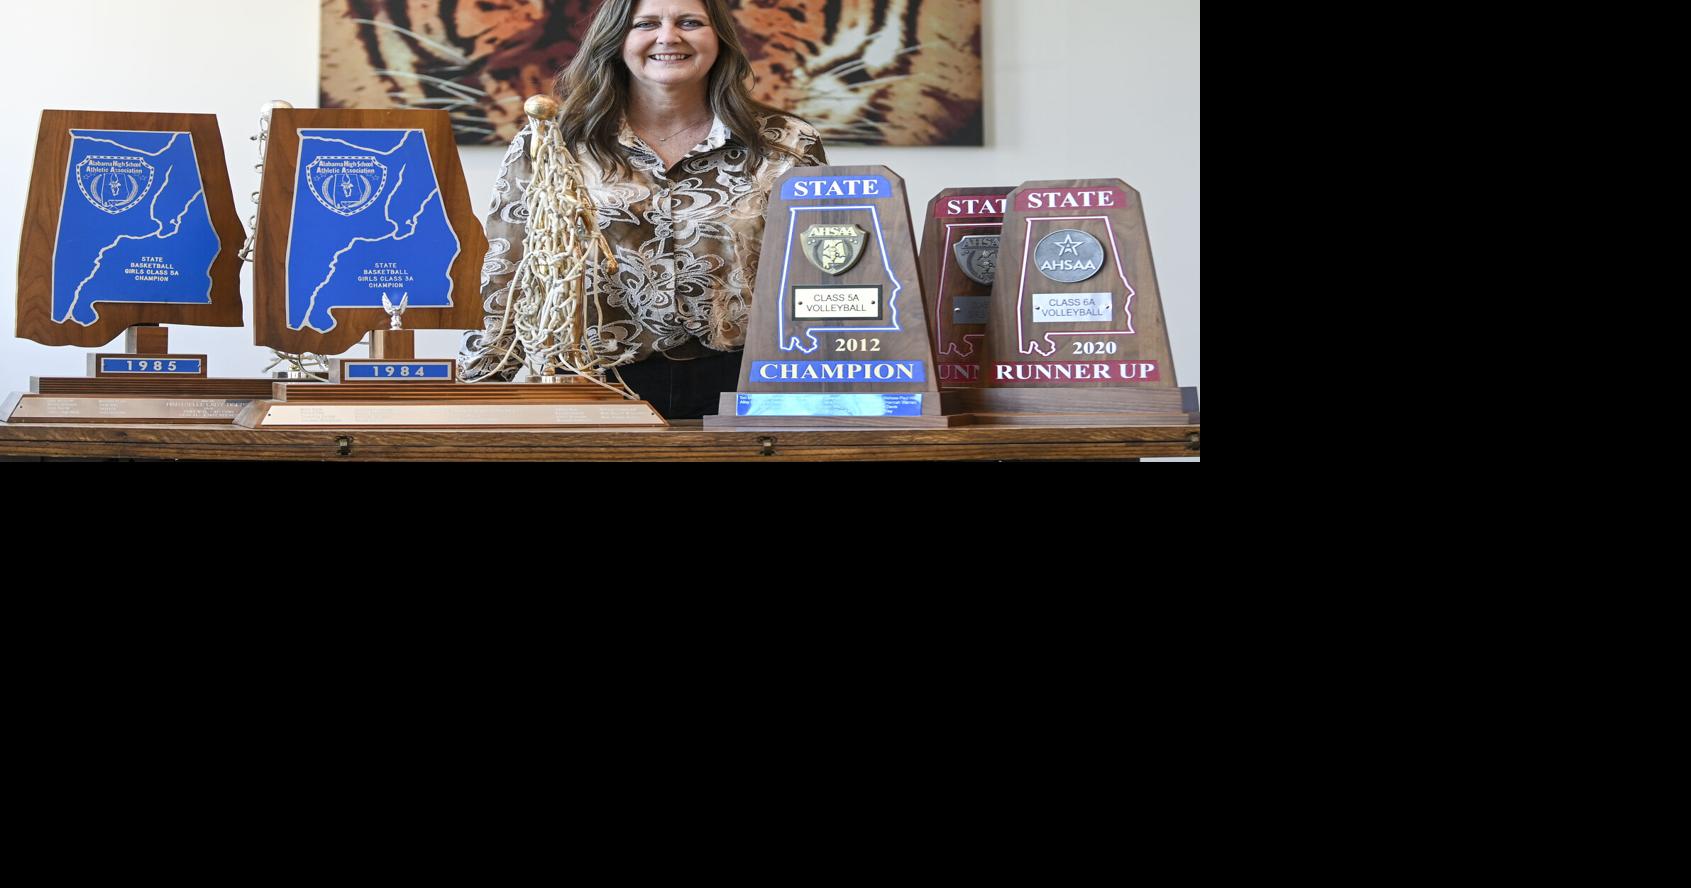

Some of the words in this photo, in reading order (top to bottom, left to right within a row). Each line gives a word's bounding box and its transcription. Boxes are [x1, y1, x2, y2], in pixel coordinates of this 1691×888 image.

[110, 166, 143, 174] Association
[341, 166, 376, 174] Association
[344, 160, 357, 168] High
[793, 179, 880, 197] STATE
[1027, 190, 1115, 209] STATE
[947, 198, 1007, 215] STAT
[807, 226, 858, 238] AHSAA
[960, 238, 1000, 249] AHSA
[1040, 259, 1097, 271] AHSAA
[813, 293, 846, 303] CLASS
[847, 293, 860, 302] 5A
[1048, 298, 1081, 307] CLASS
[1083, 298, 1097, 306] 6A
[806, 303, 868, 313] VOLLEYBALL
[1041, 308, 1104, 317] VOLLEYBALL
[834, 338, 881, 352] 2012
[1072, 341, 1118, 355] 2020
[126, 360, 177, 371] 1985
[372, 365, 425, 377] 1984
[759, 362, 915, 380] CHAMPION
[995, 363, 1112, 380] RUNNER
[1119, 362, 1155, 379] UP
